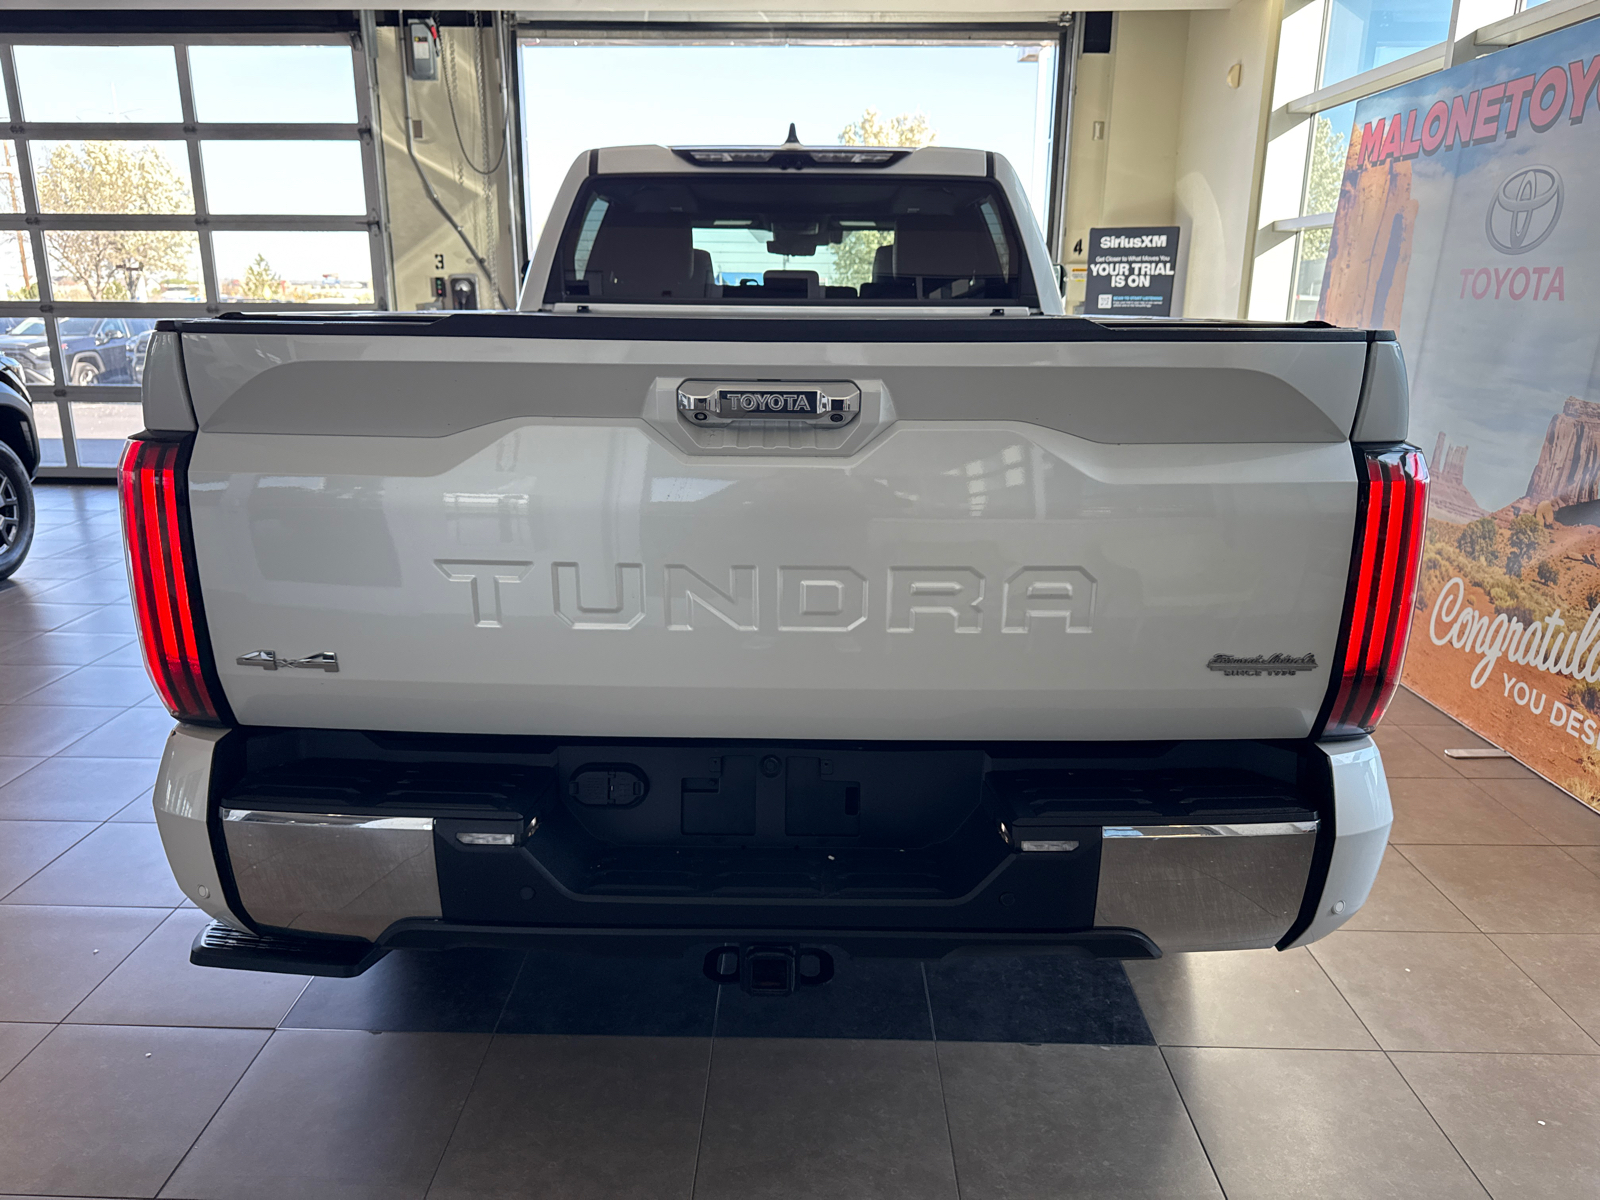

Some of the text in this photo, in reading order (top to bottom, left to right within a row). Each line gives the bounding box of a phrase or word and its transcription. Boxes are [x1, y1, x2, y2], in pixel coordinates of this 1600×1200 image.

[1357, 53, 1600, 169] MALONETOY
[1073, 239, 1083, 255] 4
[1100, 235, 1167, 249] SiriusXM
[435, 254, 444, 269] 3
[1090, 264, 1129, 276] YOUR
[1131, 263, 1174, 275] TRIAL
[1111, 275, 1150, 288] IS ON
[1459, 266, 1565, 301] TOYOTA
[726, 394, 811, 411] TOYOTA
[433, 558, 1099, 634] TUNDRA
[1503, 672, 1600, 751] YOU DES
